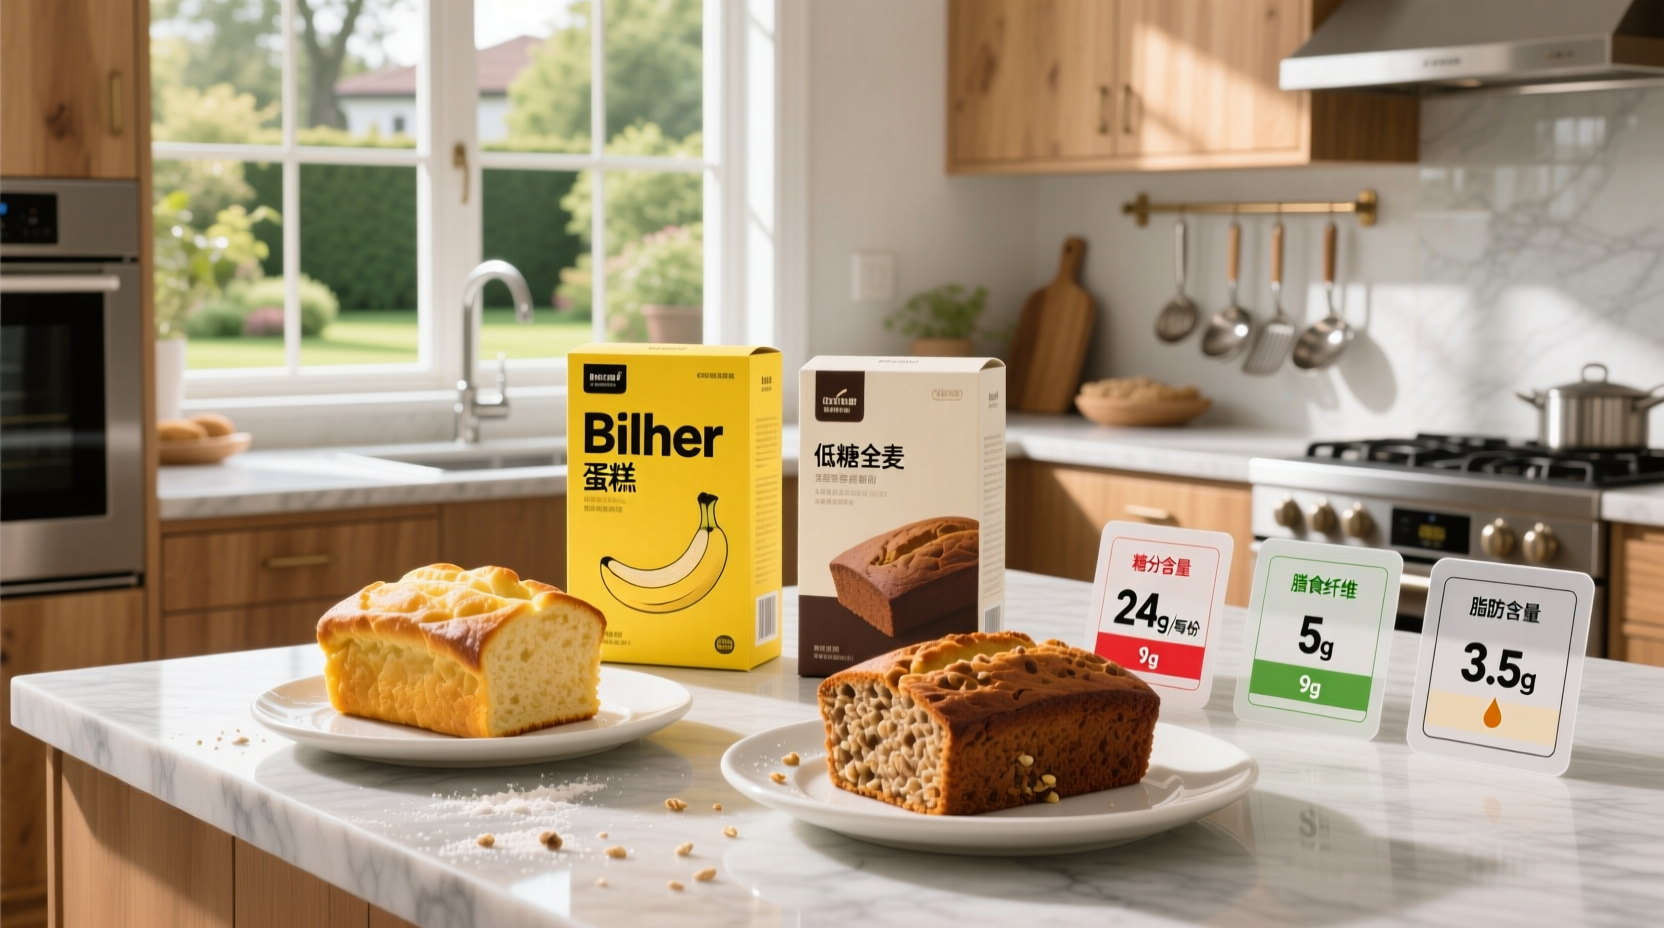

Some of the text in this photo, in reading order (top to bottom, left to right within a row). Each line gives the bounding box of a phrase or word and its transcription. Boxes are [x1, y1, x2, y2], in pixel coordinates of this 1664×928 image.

[584, 411, 724, 458] Bilher
[814, 443, 905, 470] 低糖全麦
[583, 462, 637, 493] 蛋糕
[1131, 552, 1192, 578] 糖分含量
[1469, 595, 1542, 624] 脂肪含量
[1298, 615, 1335, 662] 5g
[1138, 646, 1160, 670] 9g
[1460, 642, 1537, 696] 3.5g
[1299, 674, 1322, 700] 9g
